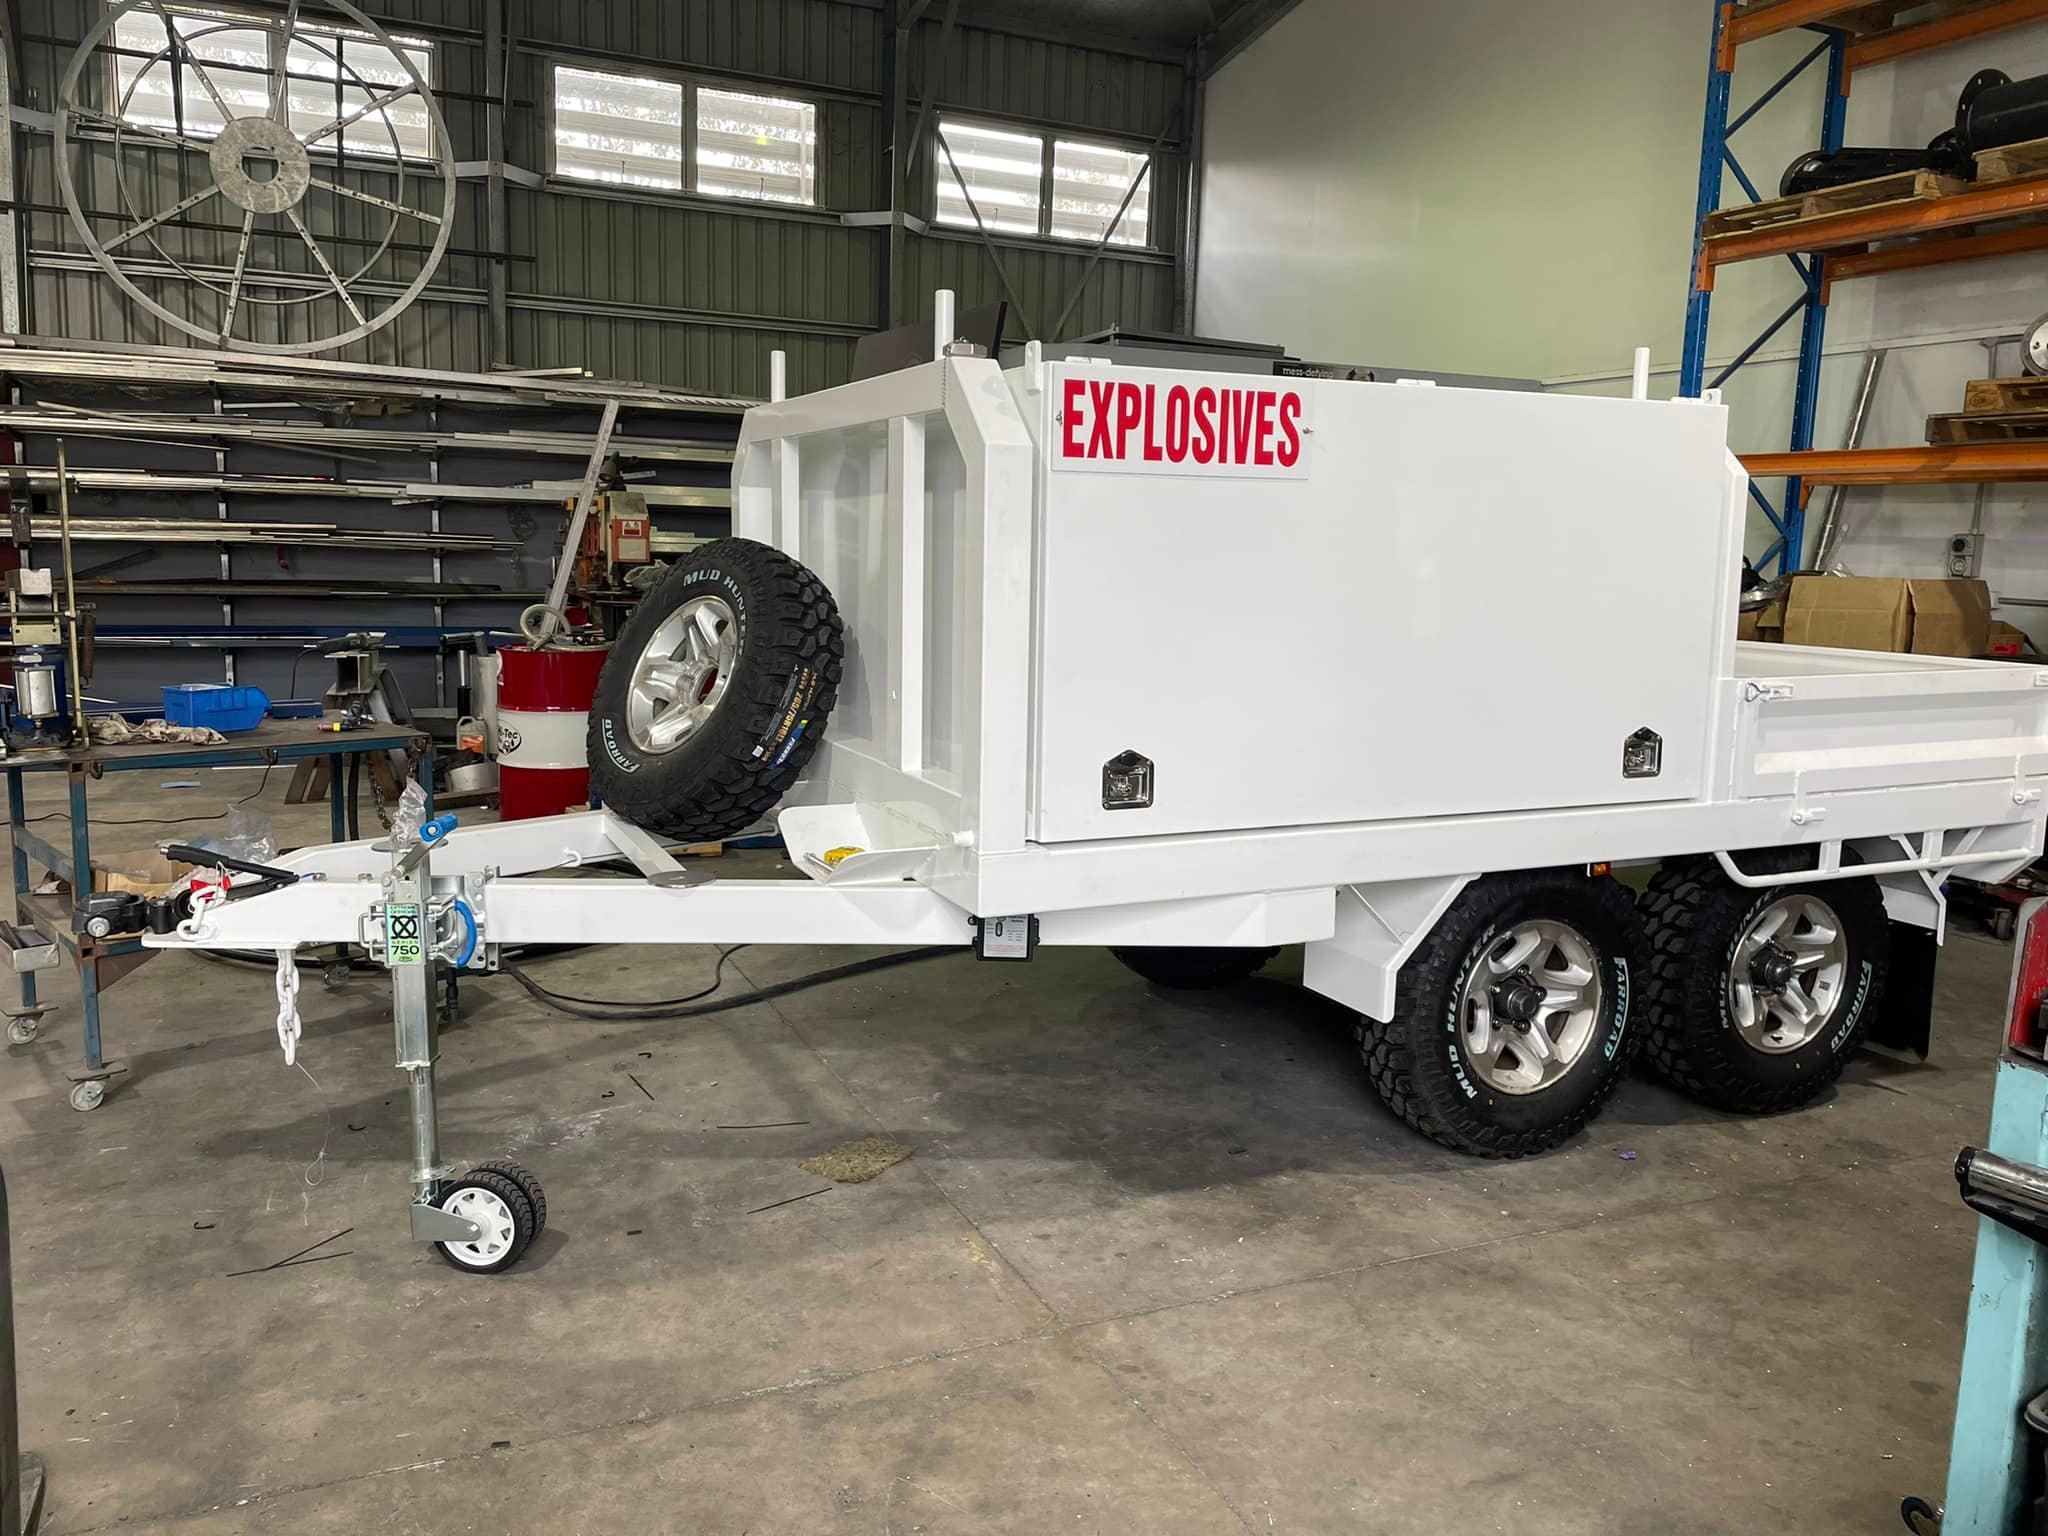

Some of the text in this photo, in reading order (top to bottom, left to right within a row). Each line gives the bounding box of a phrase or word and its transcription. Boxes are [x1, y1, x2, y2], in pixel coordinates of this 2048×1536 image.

[1062, 378, 1302, 468] EXPLOSIVES
[683, 568, 747, 656] MUD HUNTER
[601, 718, 641, 773] FARROAD
[391, 945, 420, 955] 750
[1447, 923, 1497, 1099] MUD HUNTER
[1603, 957, 1630, 1062] FARROAD
[1719, 970, 1730, 1029] MUD
[1830, 960, 1873, 1054] FARROAD
